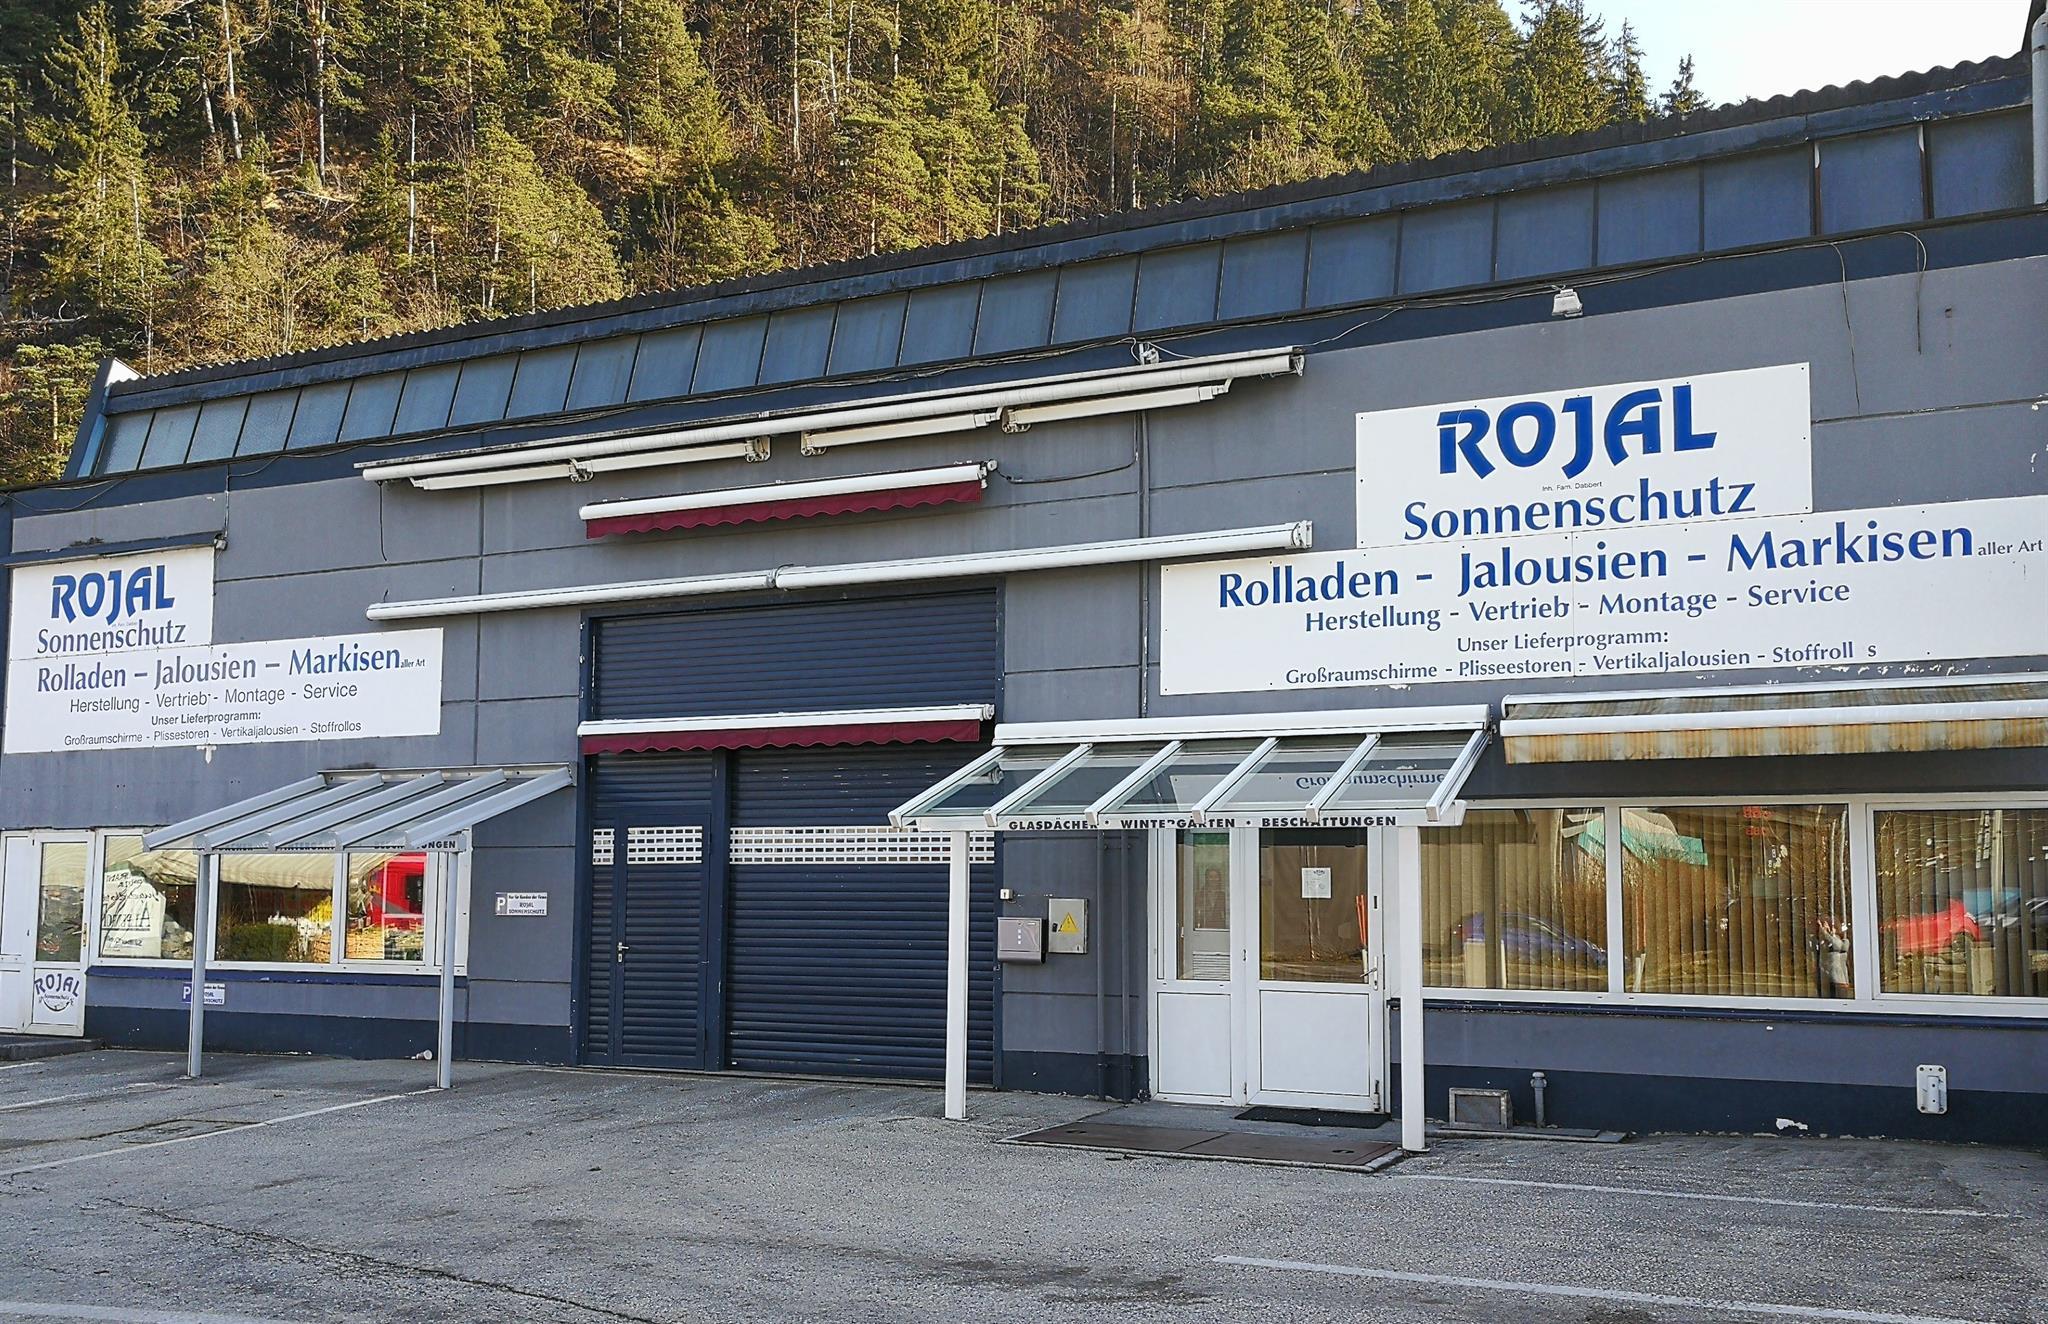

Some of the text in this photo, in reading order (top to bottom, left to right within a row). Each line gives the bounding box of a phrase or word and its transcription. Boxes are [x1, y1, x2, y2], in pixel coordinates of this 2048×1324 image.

[1436, 384, 1718, 480] ROJAL
[1403, 476, 1756, 541] Sonnenschutz
[1219, 560, 1399, 608] Rolladen
[1458, 541, 1668, 597] Jalousien
[1727, 520, 1973, 572] Markisen
[1977, 541, 2013, 556] aller
[2018, 538, 2043, 553] Art
[51, 565, 175, 625] ROJAL
[1305, 607, 1441, 632] Herstellung
[1468, 595, 1569, 622] Vertrieb
[1599, 591, 1718, 618] Montage
[1748, 579, 1850, 606] Service
[37, 619, 186, 654] Sonnenschutz
[1457, 629, 1669, 652] Unser Lieferprogramm:
[38, 662, 126, 692] Rolladen
[155, 652, 256, 690] Jalousien
[289, 643, 400, 676] Markisen
[401, 659, 414, 668] aller
[415, 658, 425, 667] Art
[1286, 662, 1438, 684] Großraumschirme
[1458, 659, 1572, 676] Plisseestoren
[1593, 648, 1750, 671] Vertikaljalousien
[70, 695, 139, 714] Herstellung
[156, 692, 208, 708] Vertrieb
[225, 687, 285, 704] Montage
[303, 683, 357, 699] Service
[64, 731, 142, 746] Großraumschirme
[154, 727, 209, 740] Plissestoren
[221, 724, 298, 738] Vertikaljalousien
[310, 720, 361, 734] Stoffrollos
[151, 710, 261, 726] Unser Lieferprogramm:
[34, 973, 79, 997] ROJAL
